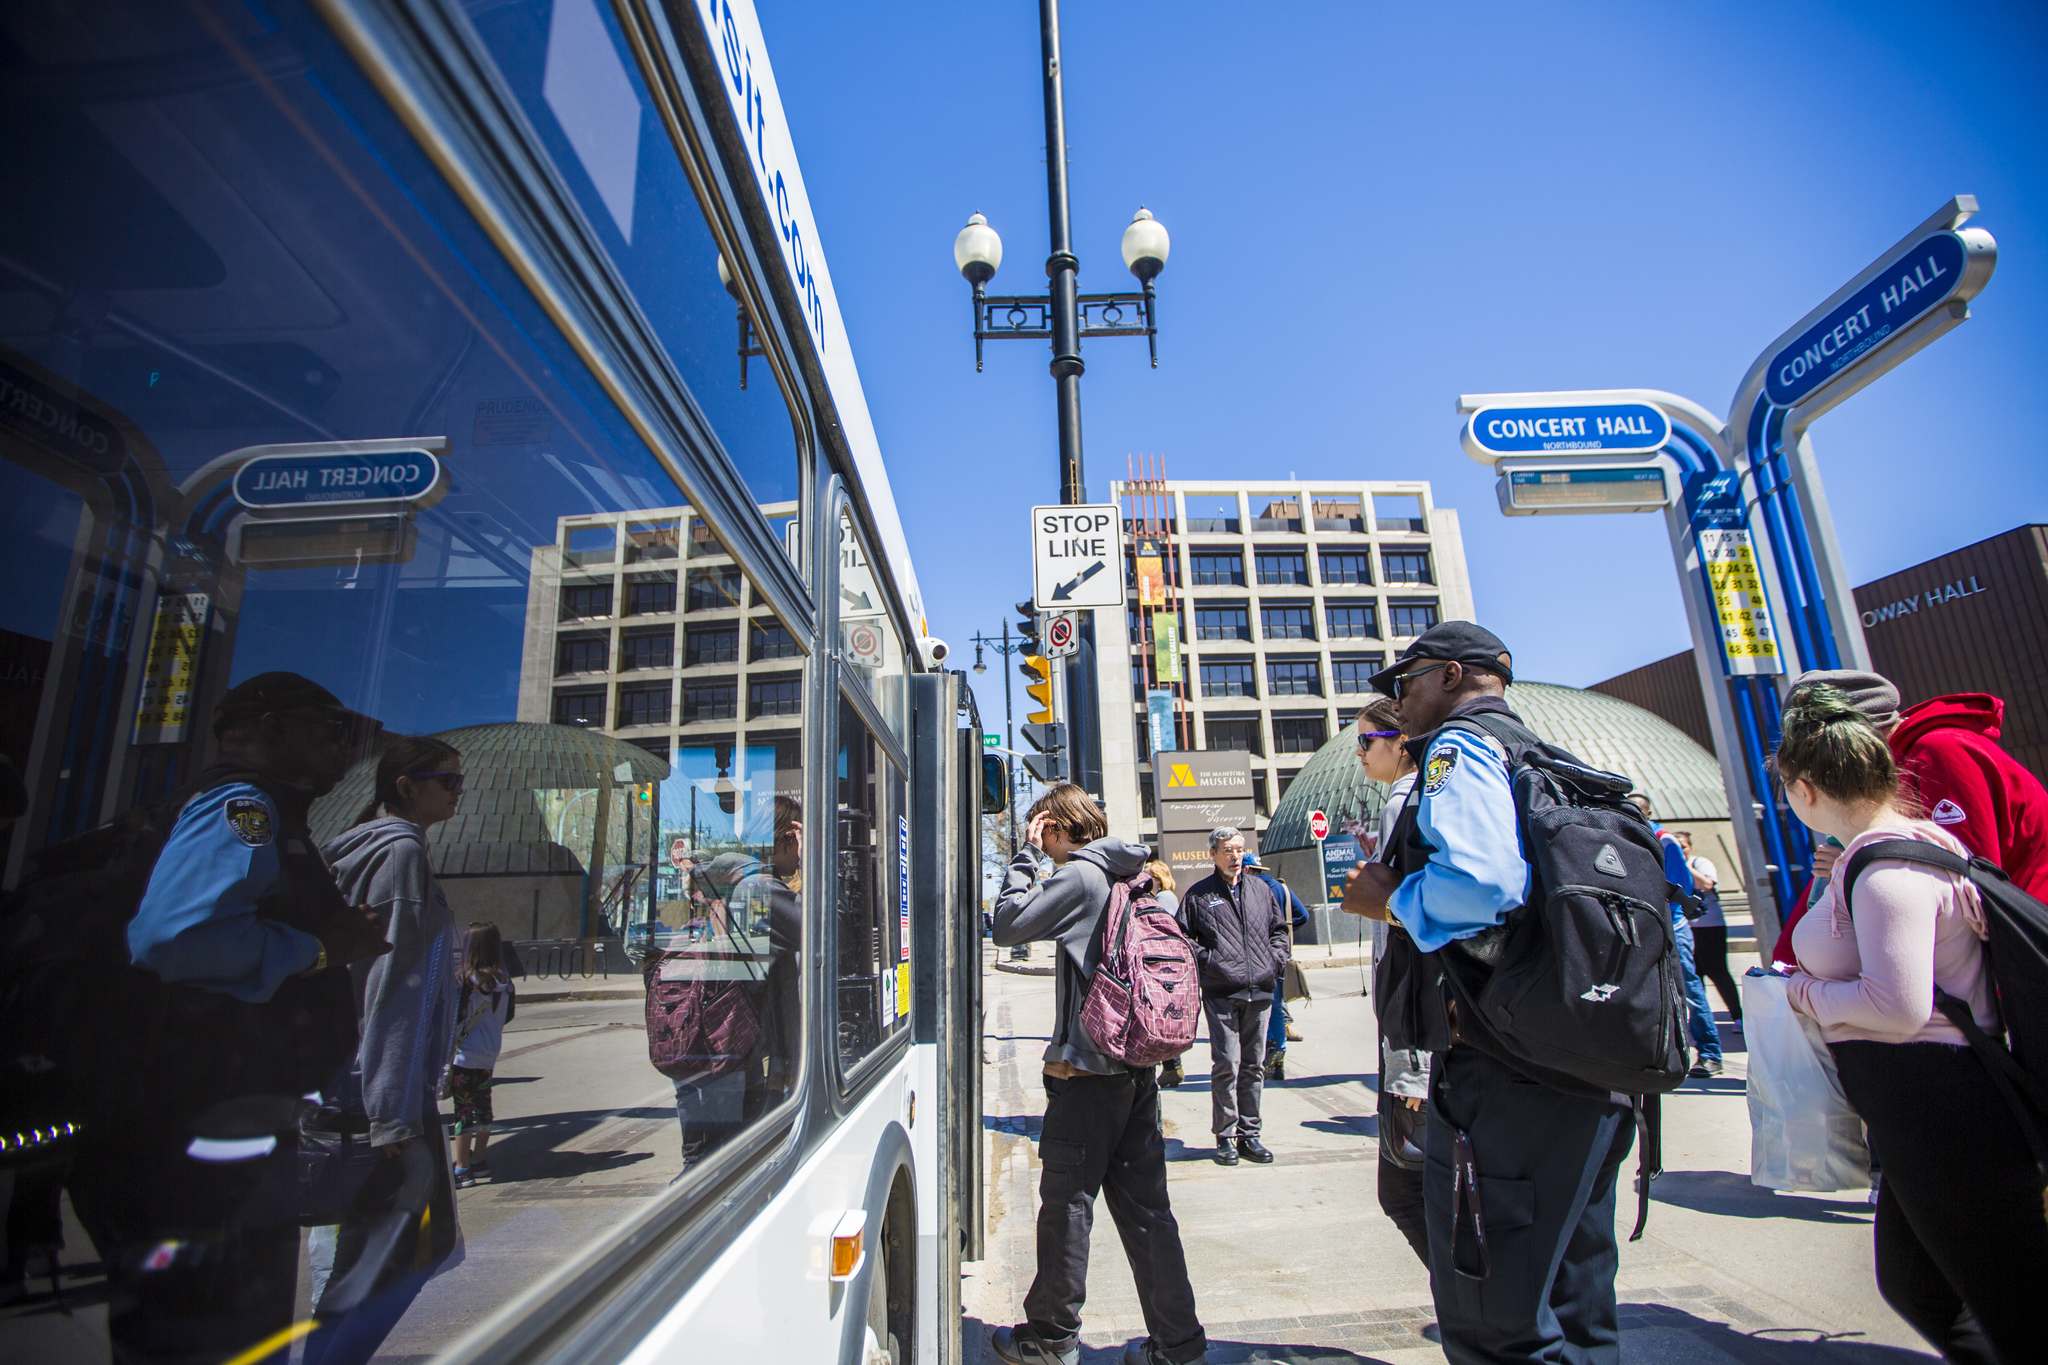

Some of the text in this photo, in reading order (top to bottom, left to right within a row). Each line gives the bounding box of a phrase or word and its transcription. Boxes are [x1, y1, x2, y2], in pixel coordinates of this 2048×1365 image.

[710, 0, 825, 353] sit.com
[1779, 255, 1947, 387] CONCERT HALL
[1487, 416, 1653, 438] CONCERT HALL
[1543, 440, 1602, 450] NORTHBOUND
[1043, 515, 1109, 533] STOP
[1704, 533, 1715, 543] 11
[1049, 539, 1106, 557] LINE
[1710, 564, 1722, 574] 22
[1728, 564, 1740, 574] 24
[1861, 575, 1987, 628] OWAY HALL
[1722, 611, 1733, 621] 41
[1739, 611, 1751, 621] 42
[1726, 628, 1738, 638] 45
[1200, 777, 1246, 787] MUSEUM
[1312, 819, 1328, 831] STOP
[1326, 848, 1354, 857] ANIMAL
